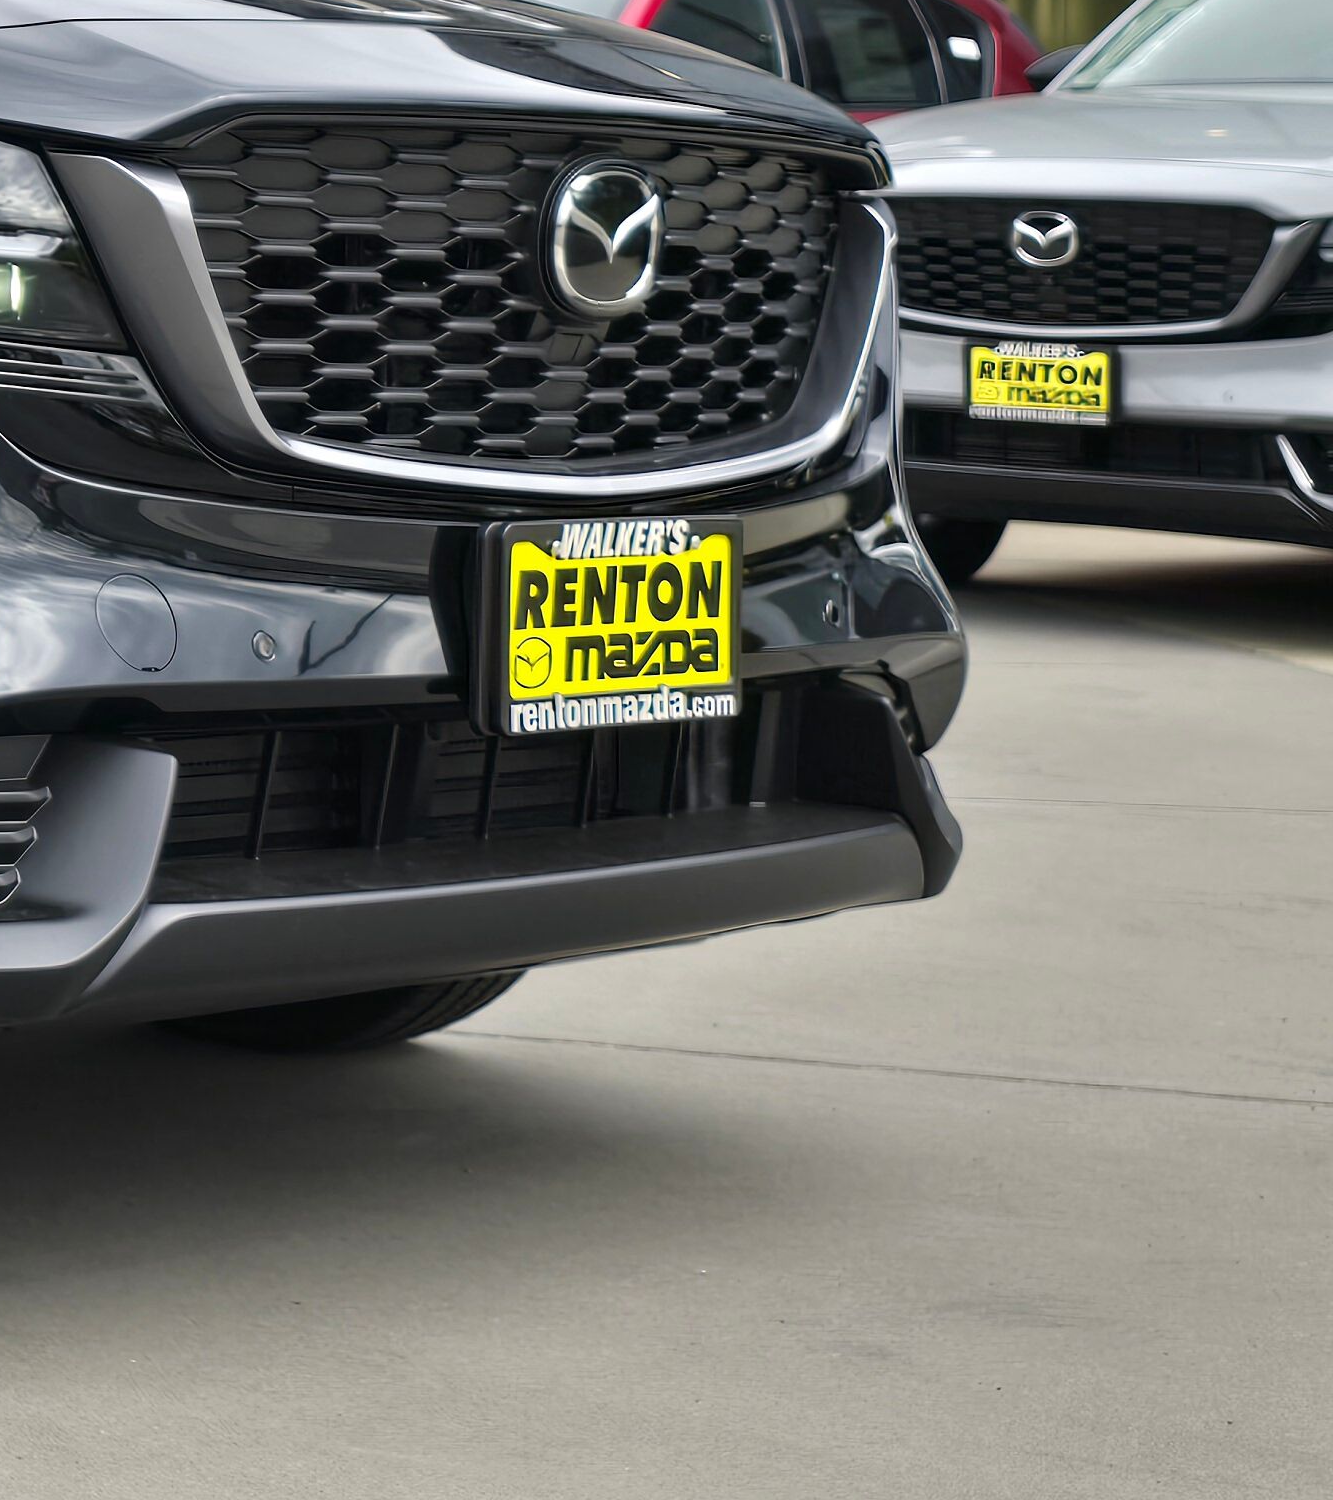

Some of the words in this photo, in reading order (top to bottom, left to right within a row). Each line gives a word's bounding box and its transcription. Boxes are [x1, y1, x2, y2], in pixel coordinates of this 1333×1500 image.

[979, 359, 1103, 387] RENTON
[557, 519, 691, 560] WALKER'S
[514, 560, 723, 631] RENTON
[510, 685, 737, 734] rentonmazda.com
